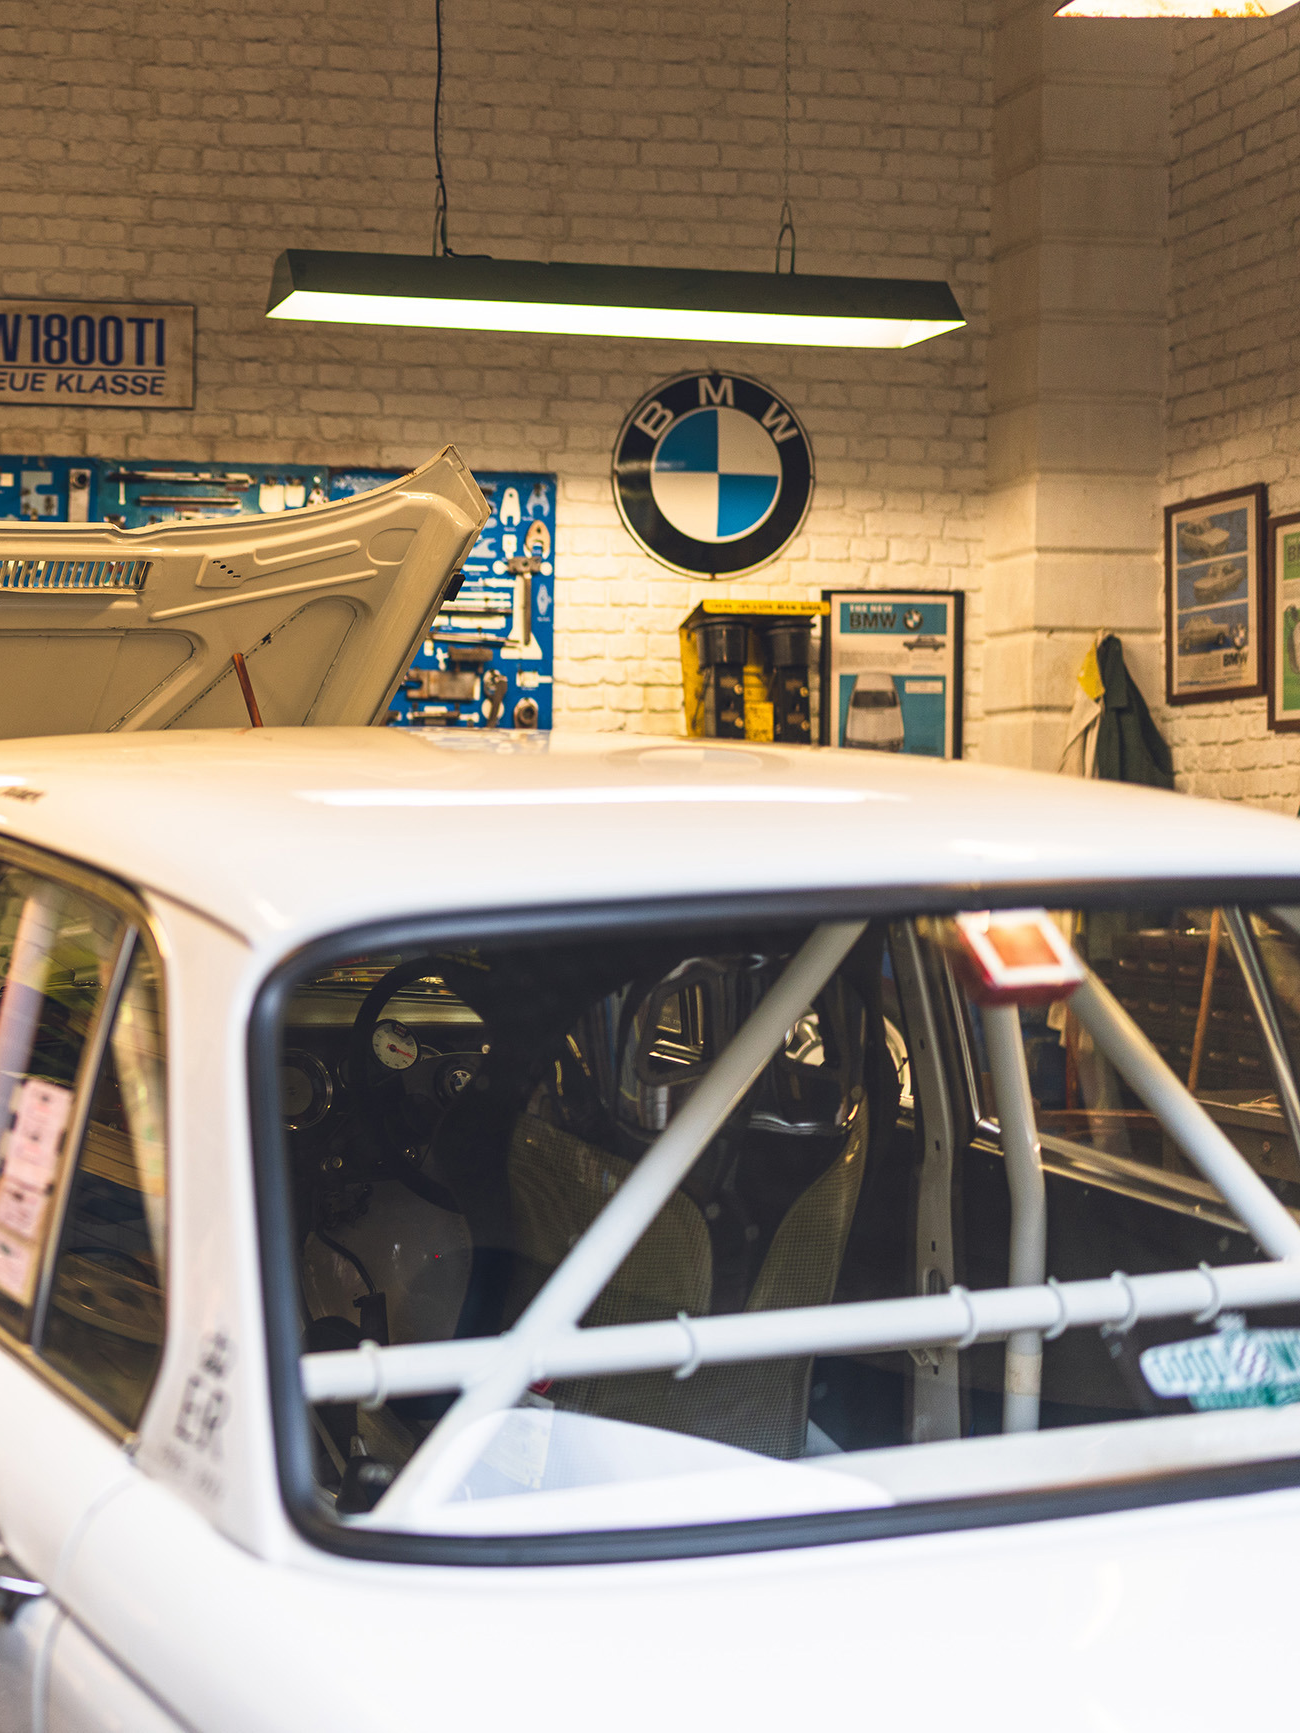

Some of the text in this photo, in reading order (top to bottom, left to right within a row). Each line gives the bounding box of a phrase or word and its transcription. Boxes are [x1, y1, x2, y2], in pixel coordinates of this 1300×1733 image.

[55, 373, 166, 396] KLASSE
[633, 377, 800, 444] BMW
[850, 612, 897, 630] BMW
